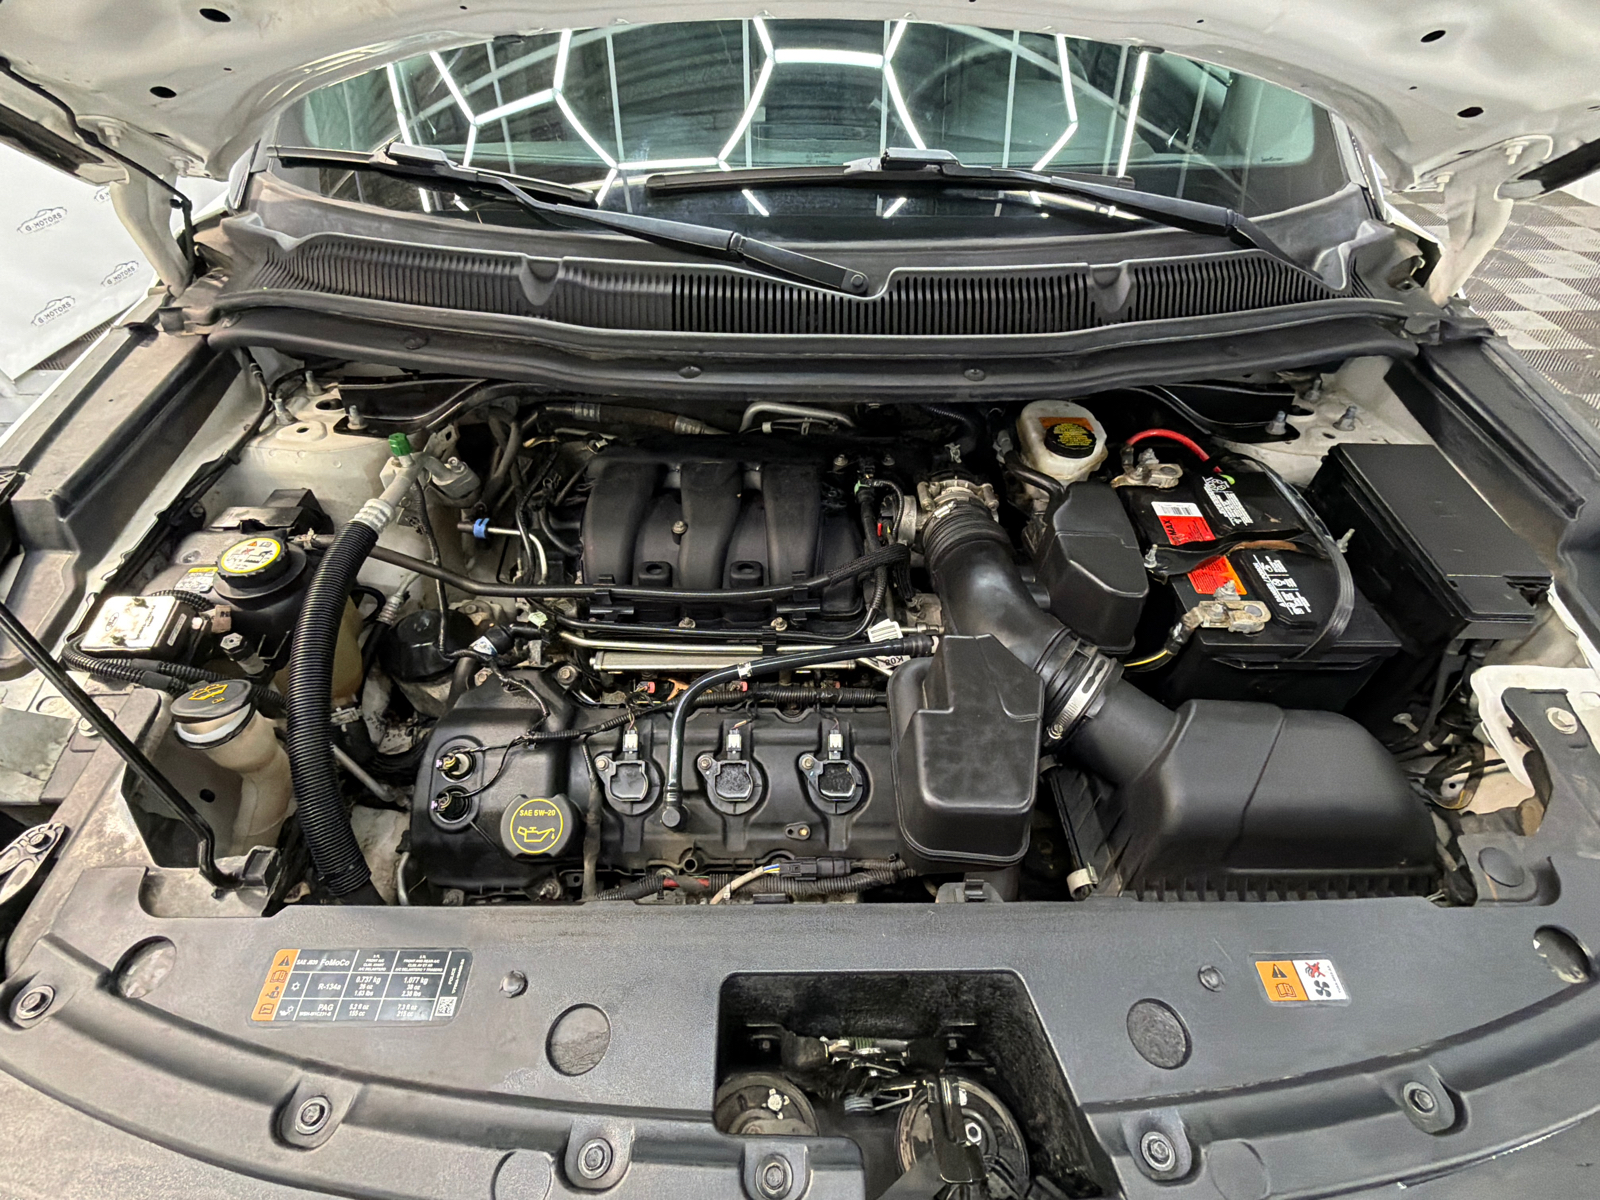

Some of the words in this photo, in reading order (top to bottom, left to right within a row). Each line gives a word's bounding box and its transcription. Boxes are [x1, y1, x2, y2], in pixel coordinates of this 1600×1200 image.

[320, 958, 350, 966] FoMoCo
[372, 976, 381, 984] kg
[420, 977, 428, 985] kg
